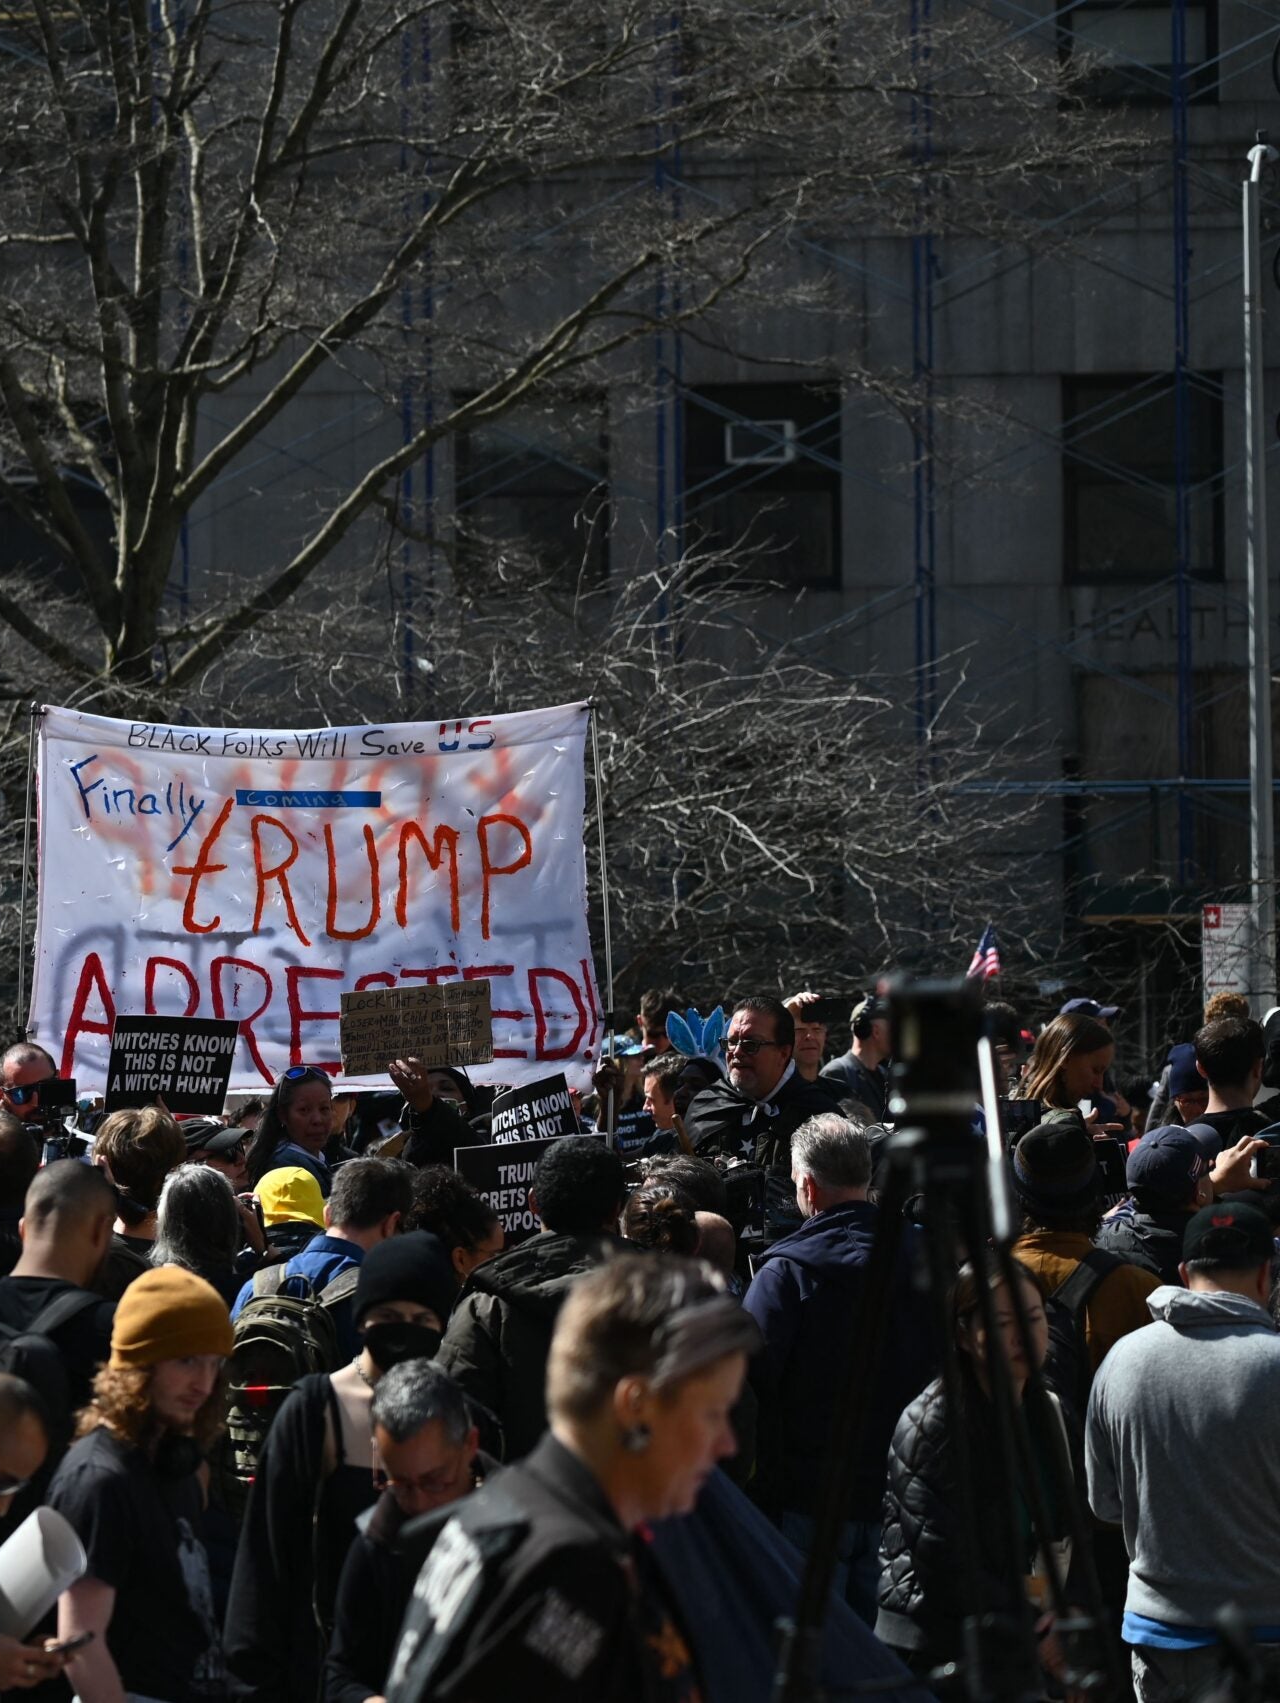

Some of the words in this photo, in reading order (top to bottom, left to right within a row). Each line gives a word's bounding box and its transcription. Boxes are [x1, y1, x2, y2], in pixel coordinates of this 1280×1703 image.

[128, 723, 211, 756] BLACK
[294, 731, 347, 758] Will
[360, 729, 425, 757] Save
[438, 720, 496, 751] US
[69, 755, 206, 852] Finally
[113, 1032, 180, 1051] WITCHES
[183, 1034, 235, 1054] KNOW
[124, 1053, 157, 1071] THIS
[160, 1053, 176, 1071] IS
[181, 1054, 216, 1074] NOT
[111, 1073, 120, 1092] A
[125, 1073, 172, 1092] WITCH
[175, 1075, 224, 1095] HUNT
[532, 1091, 570, 1119] KNOW
[495, 1128, 521, 1145] THIS
[523, 1124, 536, 1141] IS
[537, 1114, 563, 1139] NOT
[498, 1161, 538, 1185] TRUM
[479, 1187, 526, 1209] CRETS
